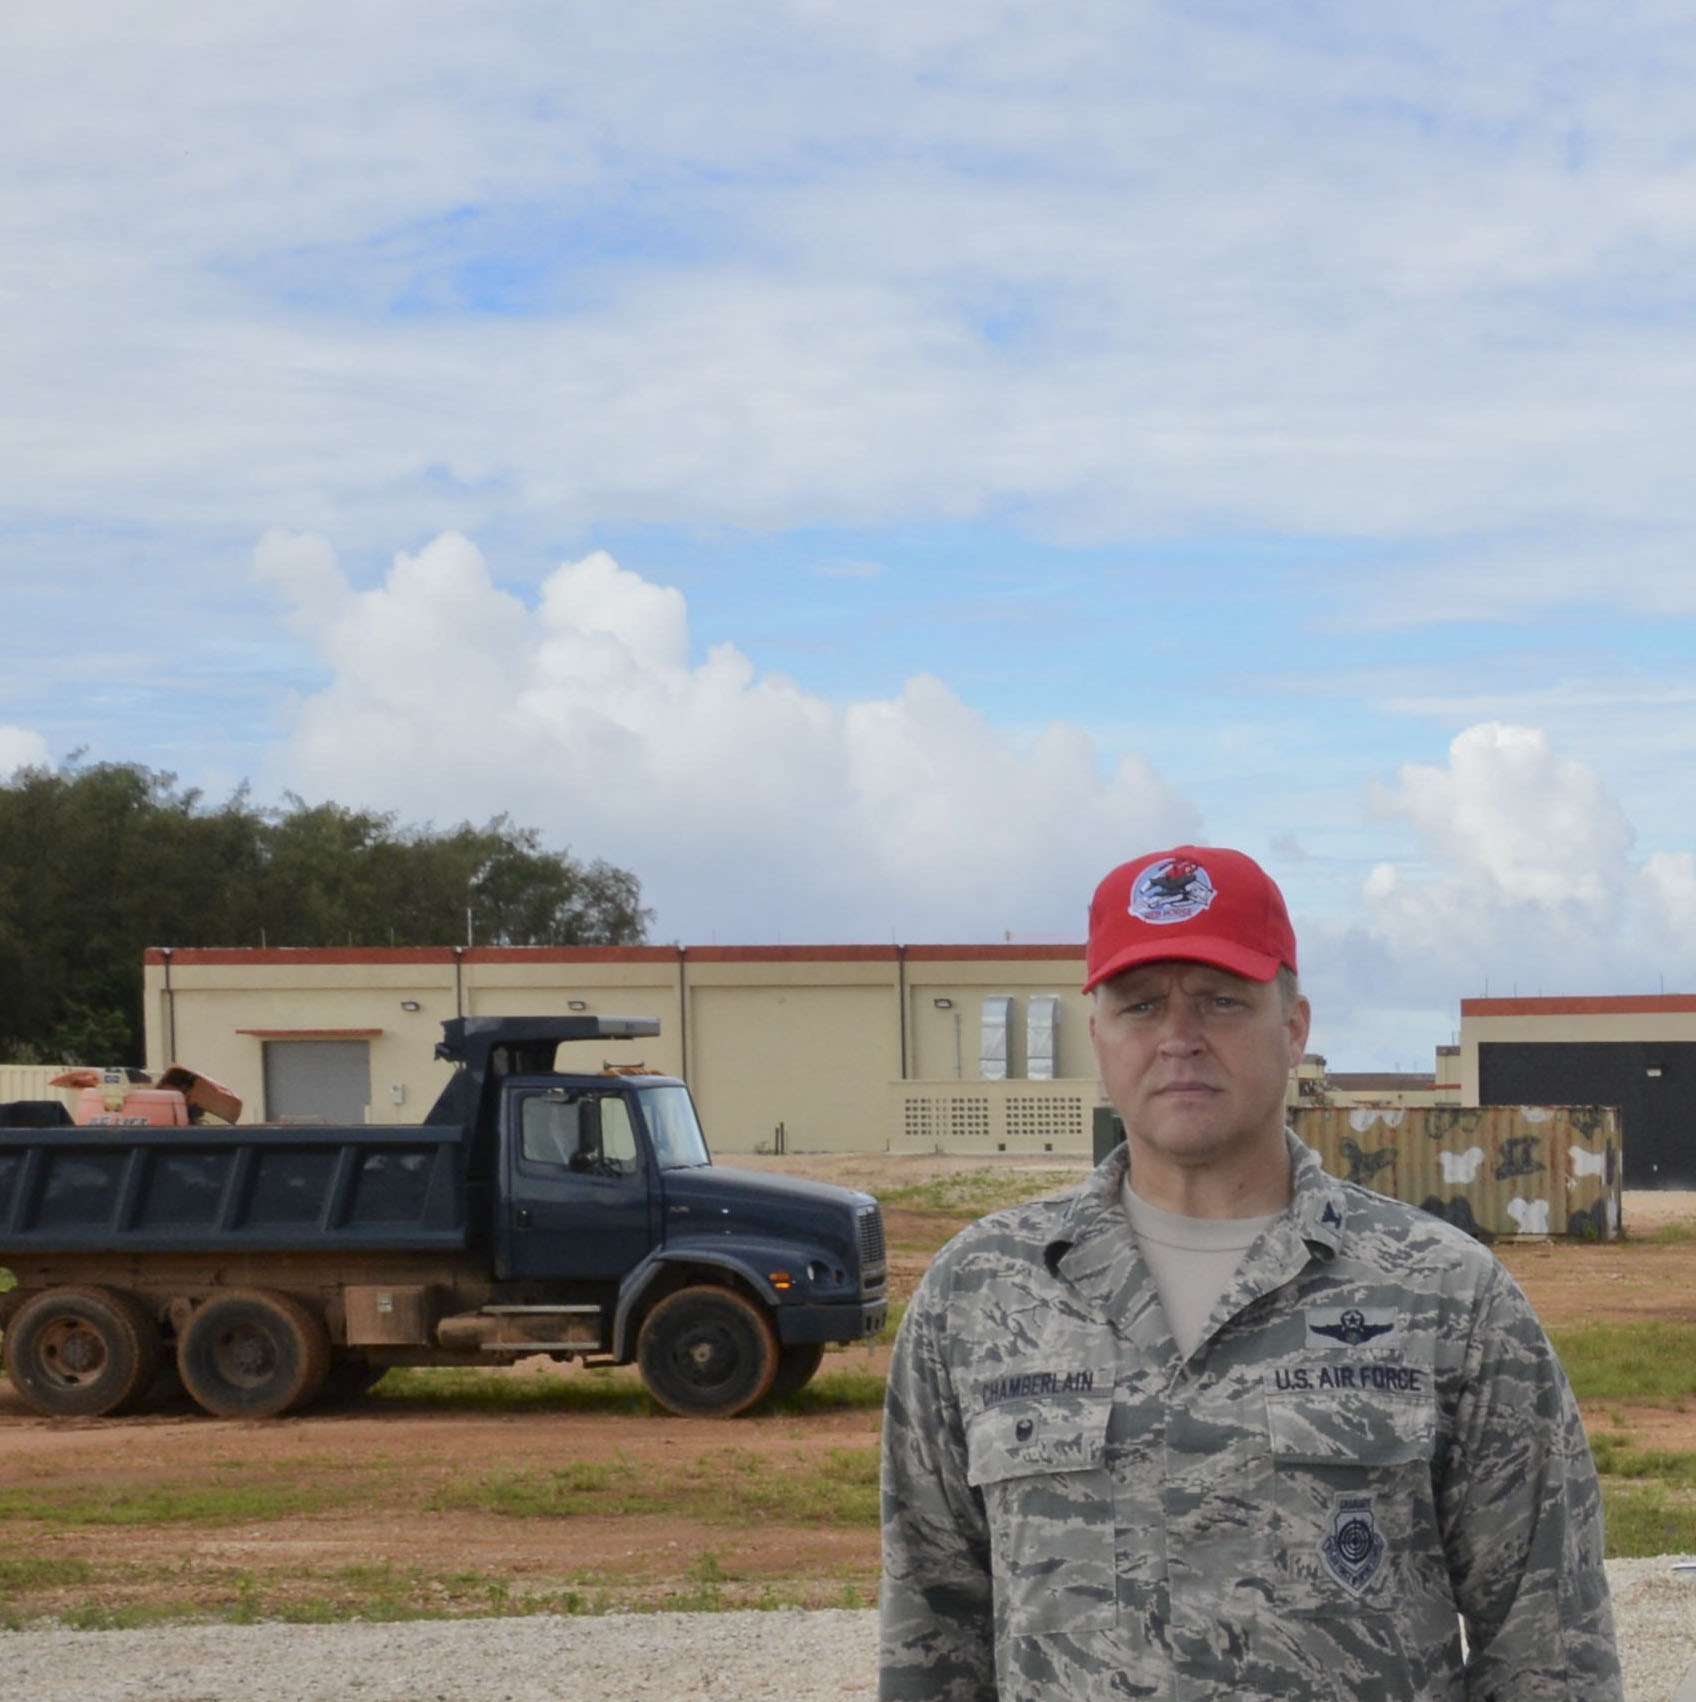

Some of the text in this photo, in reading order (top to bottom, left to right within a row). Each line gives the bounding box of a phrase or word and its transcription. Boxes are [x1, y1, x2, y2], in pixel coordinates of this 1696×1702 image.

[982, 1371, 1094, 1407] CHAMBERLAIN
[1275, 1366, 1422, 1391] U.S. AIR FORCE
